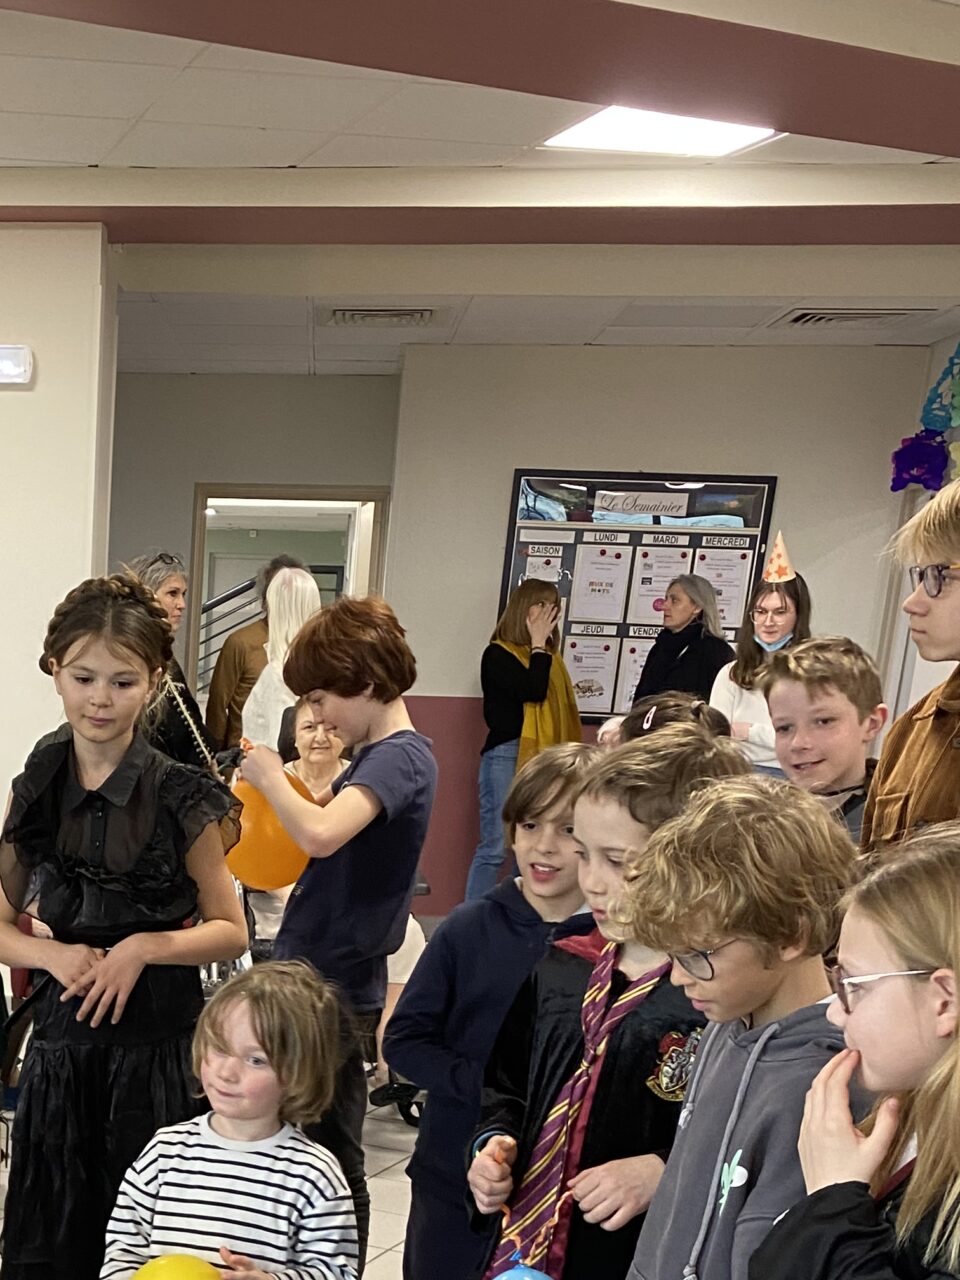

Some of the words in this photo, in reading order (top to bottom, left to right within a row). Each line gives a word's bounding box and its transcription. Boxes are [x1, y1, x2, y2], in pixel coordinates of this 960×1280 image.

[599, 494, 617, 511] Le
[621, 494, 683, 513] Semainier
[594, 532, 618, 542] LUNDI
[652, 535, 679, 545] MARDI
[705, 537, 747, 547] MERCREDI
[530, 546, 560, 555] SAISON
[581, 626, 605, 634] JEUDI
